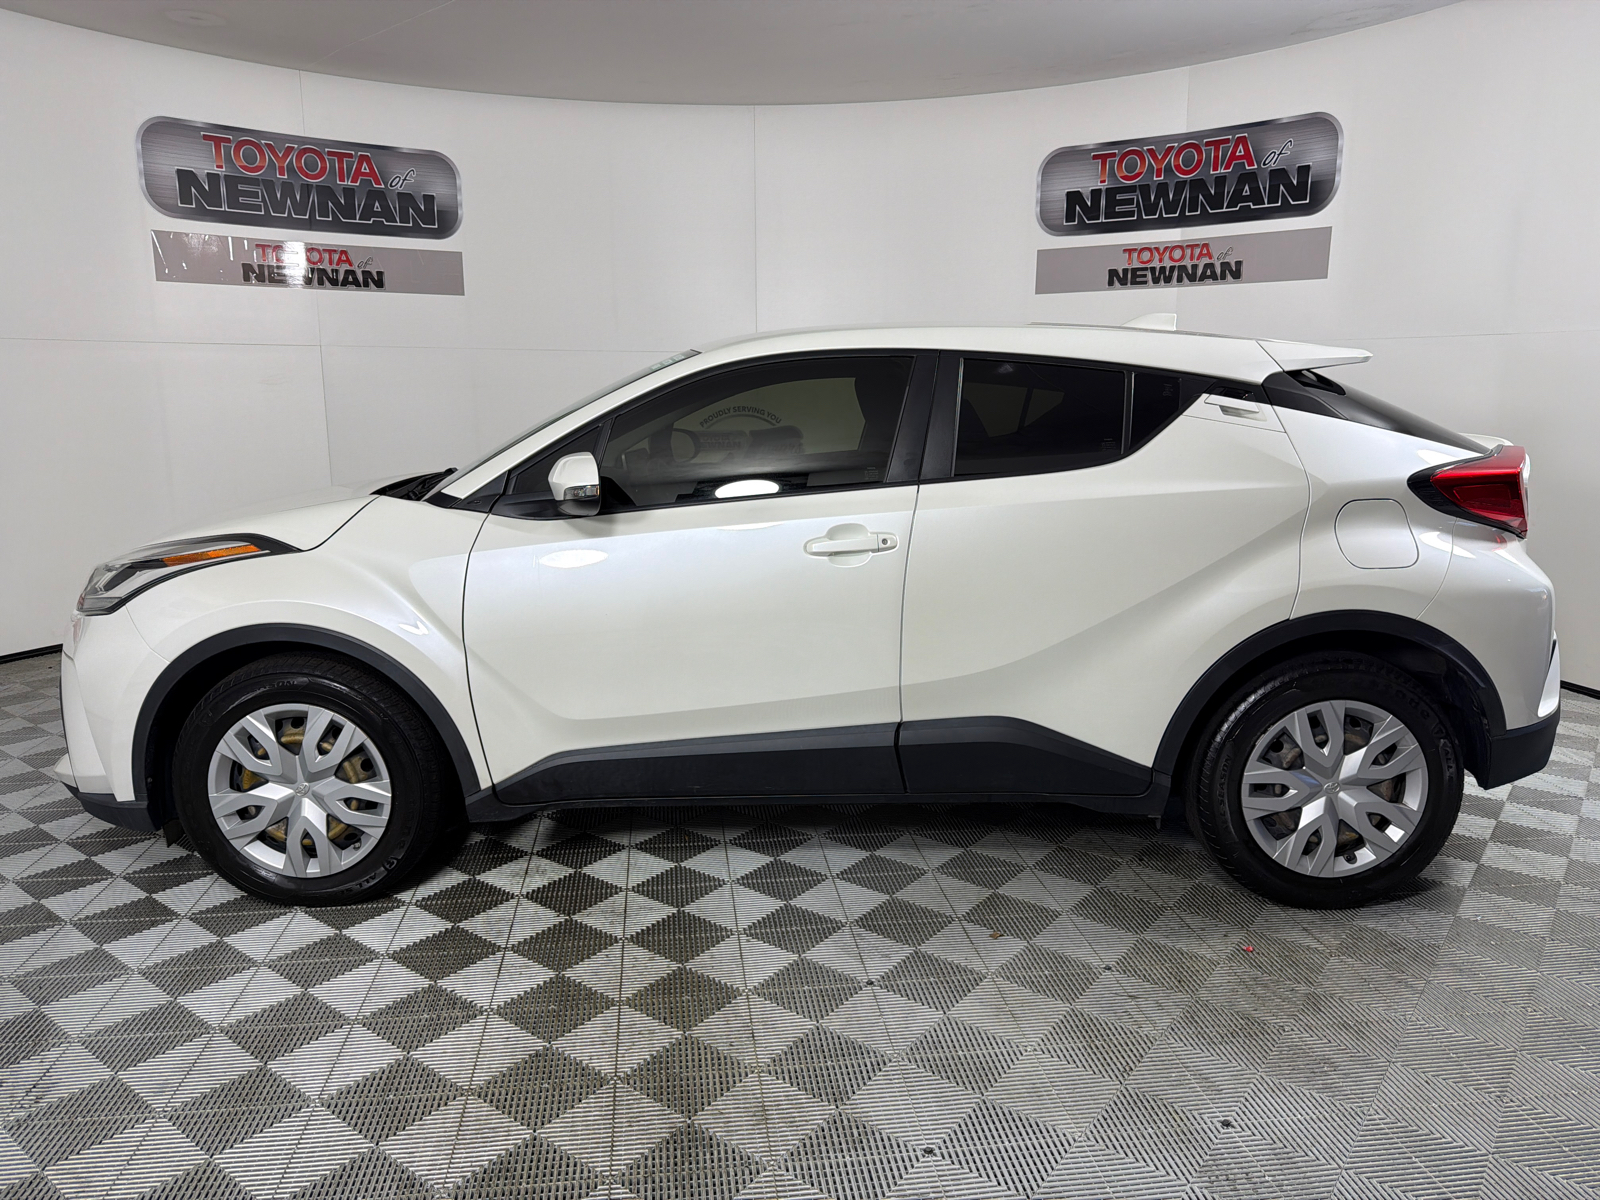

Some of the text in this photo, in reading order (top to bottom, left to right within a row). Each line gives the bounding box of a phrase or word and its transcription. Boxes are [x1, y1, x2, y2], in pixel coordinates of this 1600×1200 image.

[201, 132, 417, 189] TOYOTA of
[1091, 134, 1294, 185] TOYOTA of
[175, 167, 438, 228] NEWNAN
[1063, 164, 1312, 225] NEWNAN
[255, 243, 374, 269] TOOTA of
[1107, 260, 1242, 287] NEWNAN
[1122, 242, 1233, 266] TOYOTA of
[699, 406, 782, 428] PROUDLY SERVING YOU
[1217, 754, 1232, 807] SEASON
